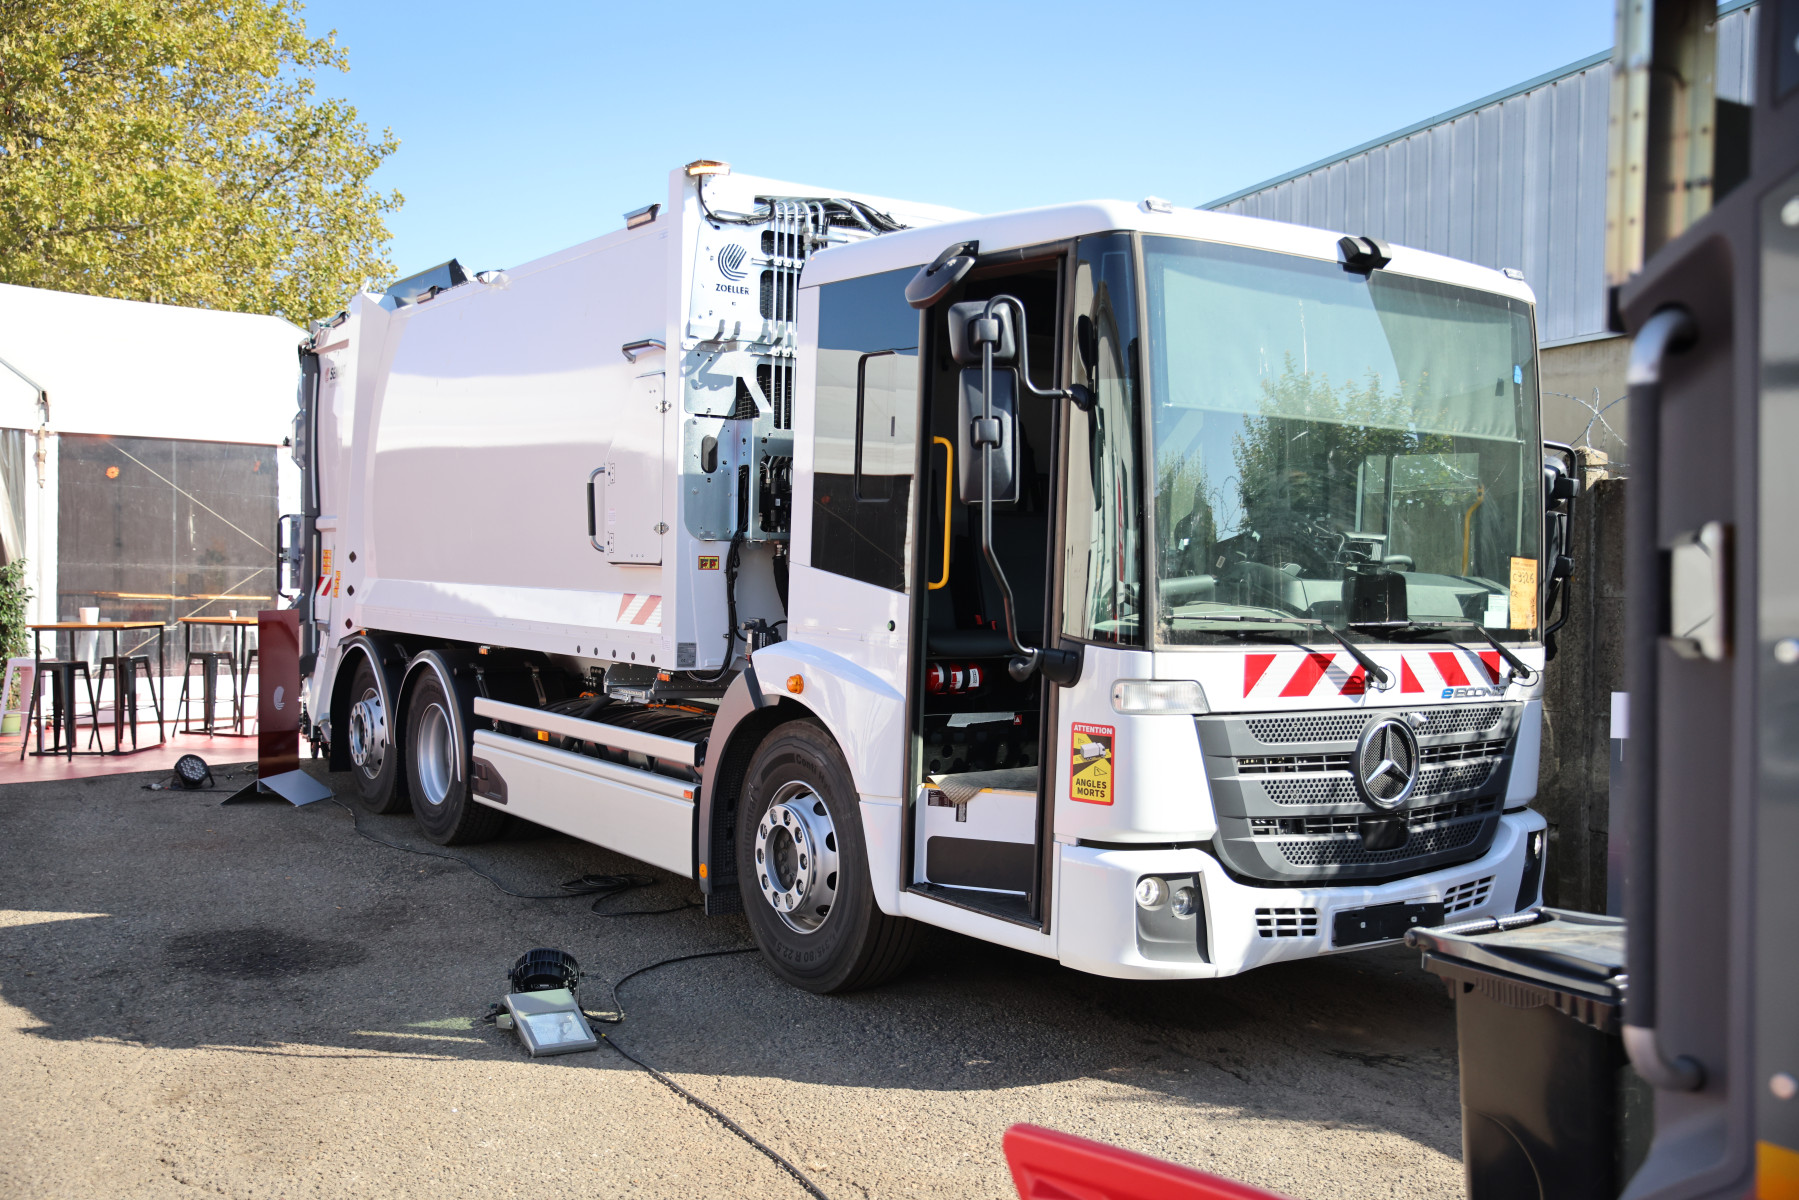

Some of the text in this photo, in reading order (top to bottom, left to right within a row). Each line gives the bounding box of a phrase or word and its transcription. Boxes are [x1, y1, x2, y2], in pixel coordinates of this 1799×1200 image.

[715, 283, 750, 295] ZOELLER
[1073, 724, 1113, 735] ATTENTION
[796, 754, 817, 775] Conti
[1075, 778, 1107, 789] ANGLES
[1077, 787, 1105, 798] MORTS
[776, 942, 794, 960] 22.5
